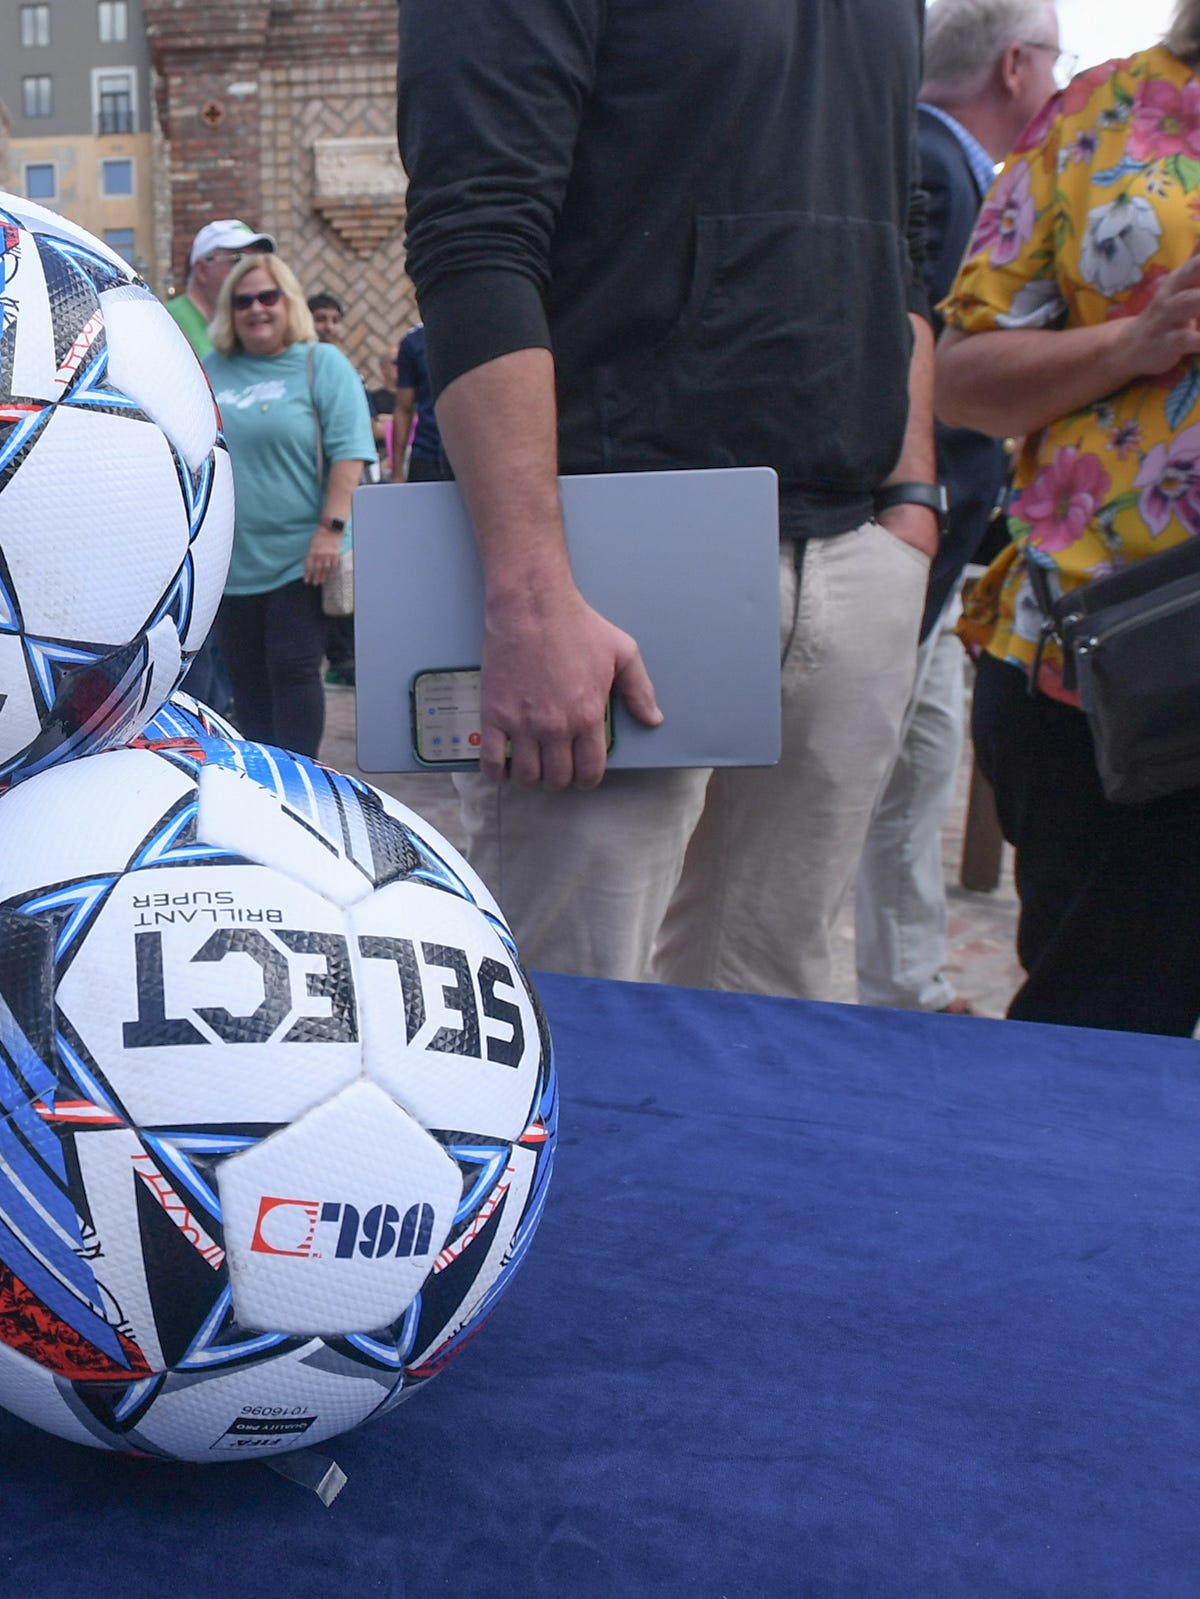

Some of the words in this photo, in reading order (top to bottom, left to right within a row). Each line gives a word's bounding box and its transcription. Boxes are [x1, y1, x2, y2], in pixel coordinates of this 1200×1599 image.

[133, 891, 234, 908] SUPER
[134, 909, 283, 927] BRILLANT
[122, 928, 526, 1068] SELECT
[320, 1202, 436, 1260] USL
[240, 1405, 309, 1416] 1016096
[236, 1423, 260, 1431] PRO
[262, 1422, 308, 1431] QUALITY
